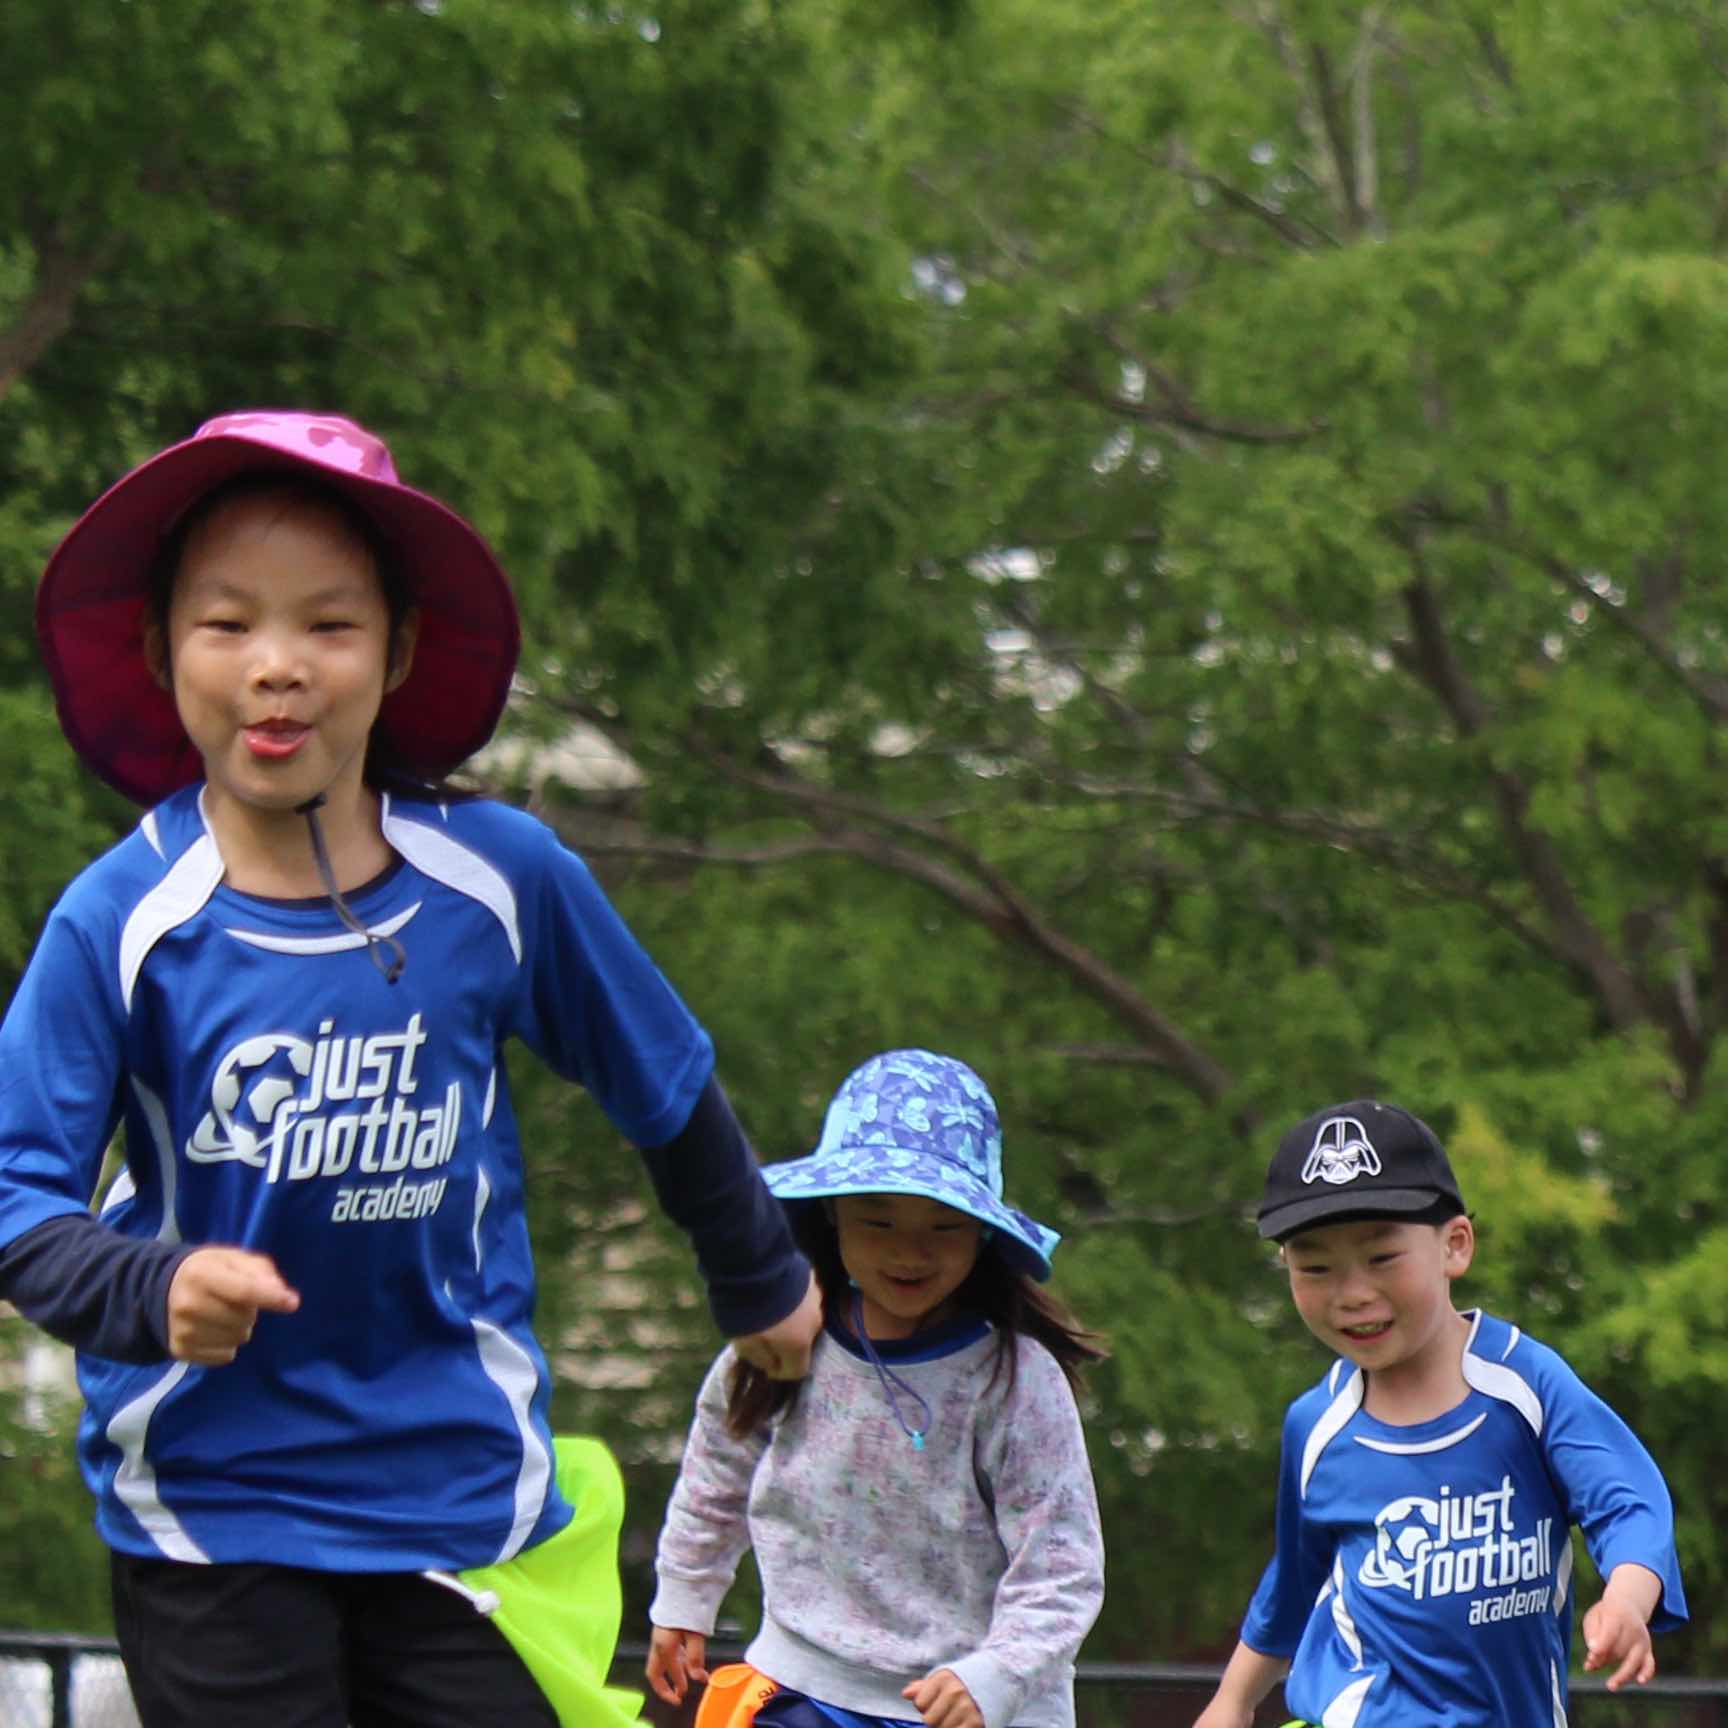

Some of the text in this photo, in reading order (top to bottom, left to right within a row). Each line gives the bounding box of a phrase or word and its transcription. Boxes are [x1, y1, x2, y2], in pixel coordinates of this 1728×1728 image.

[300, 1011, 426, 1102] just
[266, 1081, 461, 1183] football
[331, 1177, 447, 1222] academy
[1434, 1475, 1515, 1550] just
[1413, 1518, 1552, 1600] football
[1468, 1585, 1551, 1626] academy
